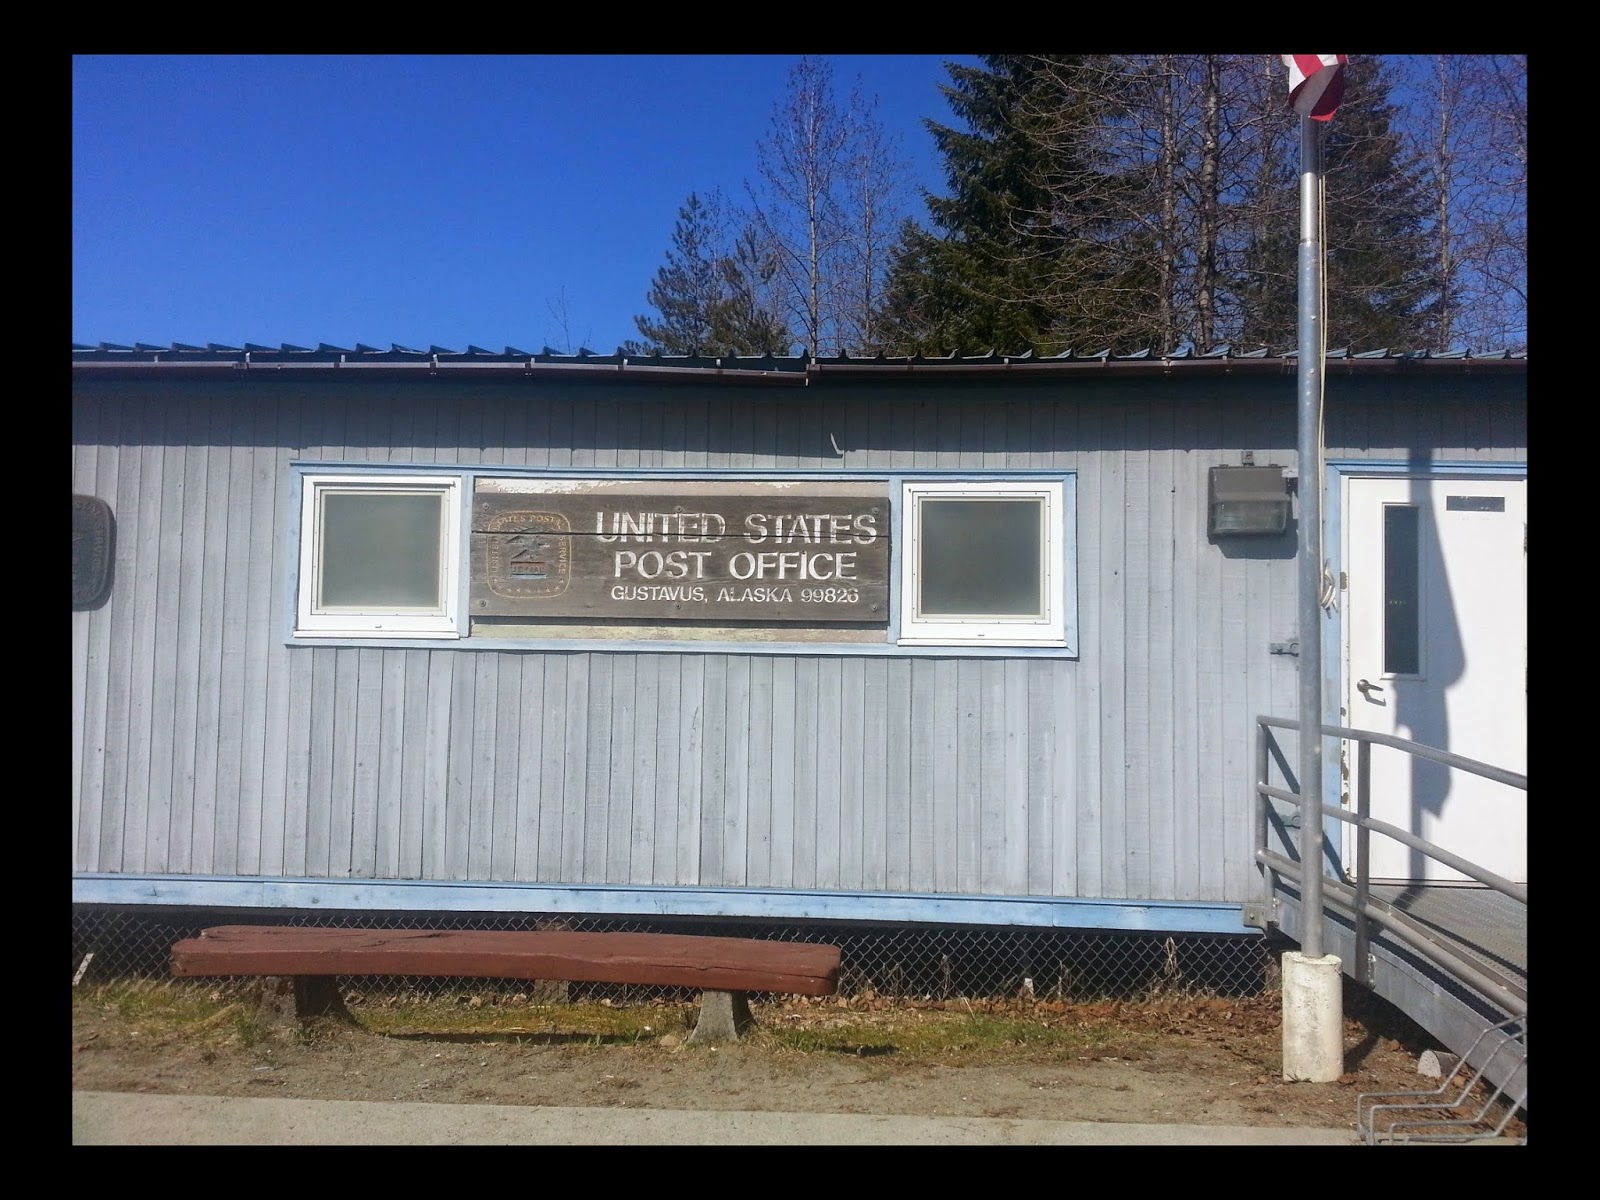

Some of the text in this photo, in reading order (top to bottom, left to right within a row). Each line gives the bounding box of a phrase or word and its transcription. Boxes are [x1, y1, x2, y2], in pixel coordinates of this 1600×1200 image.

[596, 511, 877, 545] UNITED STATES
[614, 550, 857, 580] POST OFFICE
[611, 585, 859, 603] GUSTAVUS, ALASKA 99826
